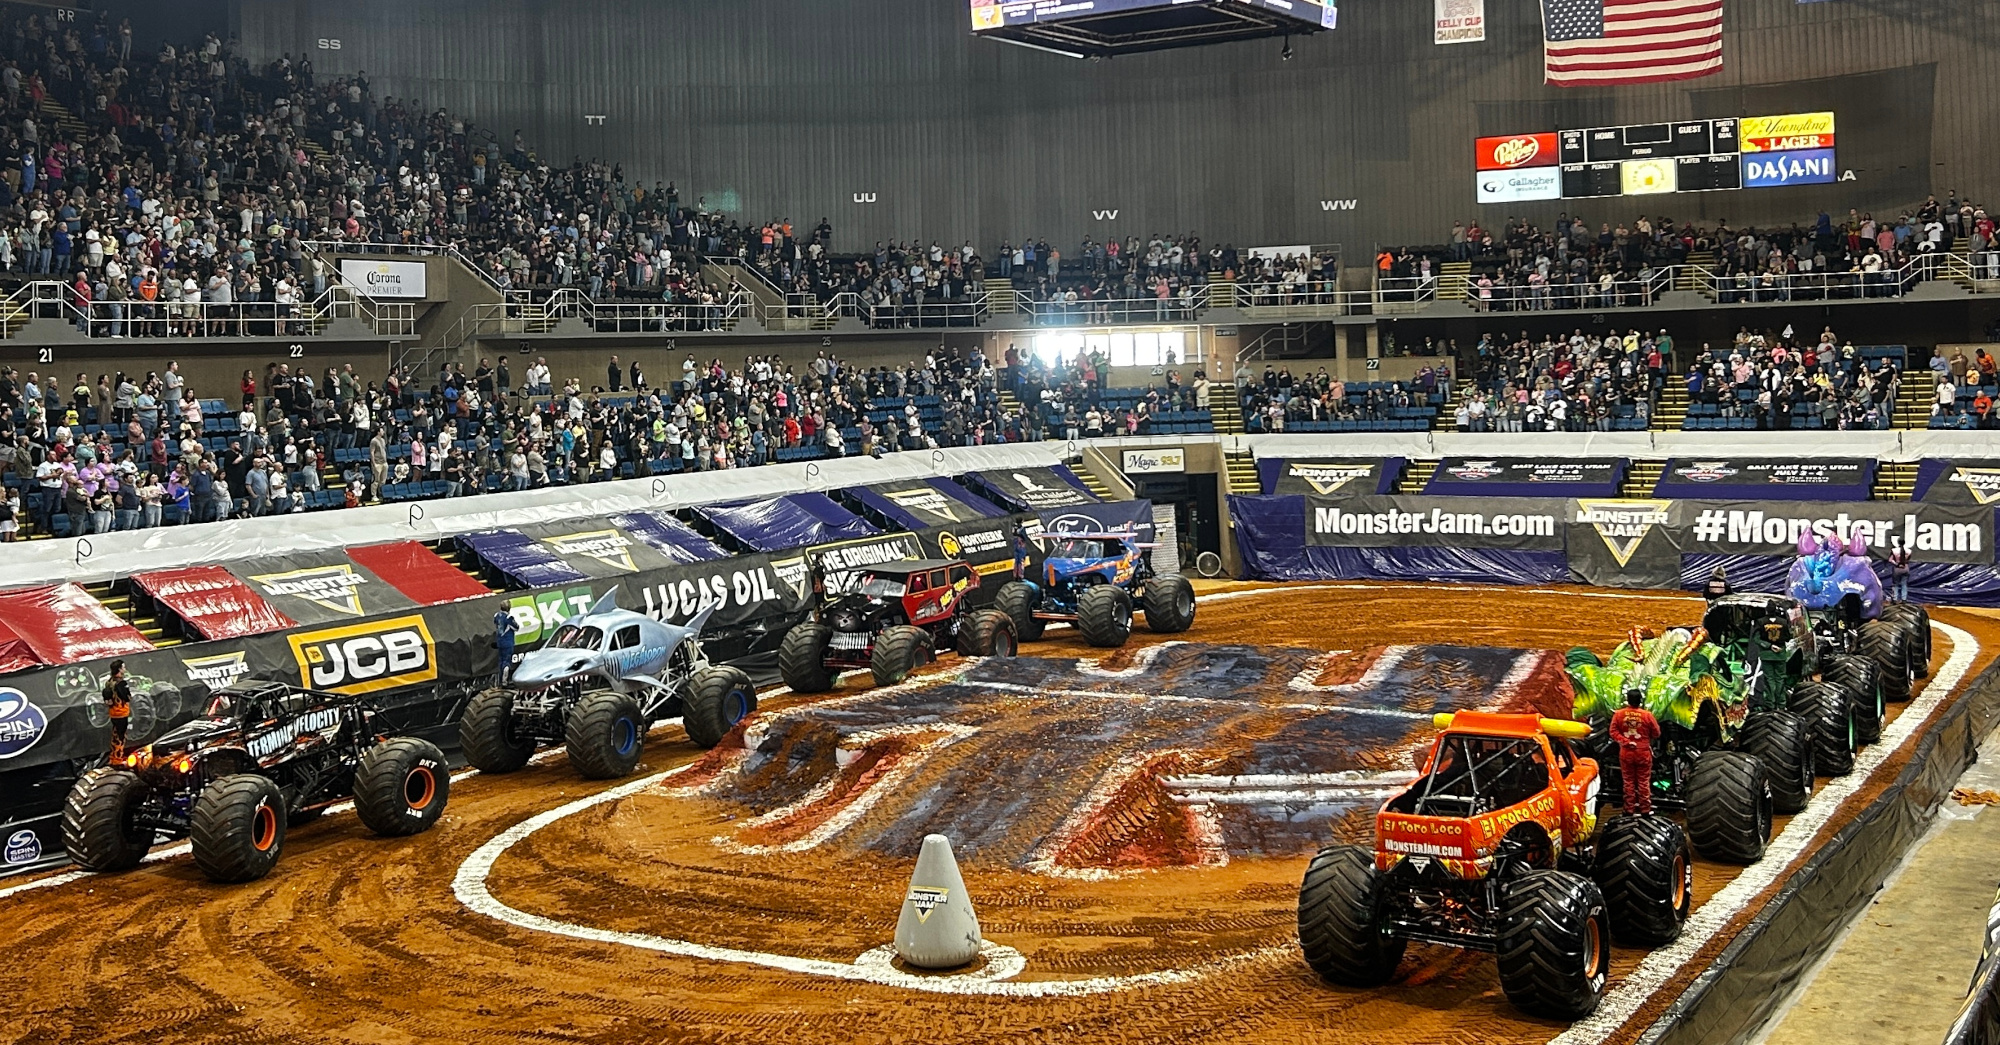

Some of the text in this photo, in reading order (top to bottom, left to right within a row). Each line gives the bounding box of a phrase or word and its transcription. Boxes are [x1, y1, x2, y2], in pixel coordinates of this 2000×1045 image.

[58, 9, 74, 22] RR
[1437, 16, 1481, 28] KELLY CUP
[1437, 27, 1482, 41] CHAMPIONS
[318, 38, 341, 50] SS
[585, 115, 606, 125] TT
[1758, 116, 1830, 136] Yuengling
[1595, 132, 1615, 140] HOME
[1678, 125, 1702, 134] GUEST
[1508, 139, 1526, 151] Dr
[1770, 135, 1820, 150] LAGER
[1499, 142, 1535, 164] Pepper
[1748, 156, 1828, 181] DASANI
[1509, 176, 1555, 188] Gallagher
[853, 192, 877, 203] UU
[1320, 199, 1357, 211] WW
[1092, 209, 1119, 220] VV
[367, 271, 401, 285] Corona
[367, 286, 402, 295] PREMIER
[39, 347, 53, 363] 21
[290, 344, 303, 358] 22
[1151, 366, 1163, 375] 26
[1366, 359, 1379, 369] 27
[1127, 454, 1181, 471] Magic 93.7
[1289, 468, 1371, 477] MONSTER
[1315, 507, 1554, 536] MonsterJam.com
[1576, 510, 1668, 524] MONSTER
[1601, 523, 1643, 537] JAM
[1692, 509, 1981, 552] #MonsterJam
[553, 536, 633, 555] MONSTER
[958, 530, 1005, 547] NORTHERN
[592, 546, 627, 557] JAM
[841, 541, 905, 566] ORIGINAL
[773, 563, 809, 577] MONSTER
[261, 573, 368, 596] MONSTER
[783, 573, 805, 584] JAM
[308, 588, 355, 600] JAM
[642, 575, 728, 621] LUCAS
[509, 594, 592, 636] BKT
[313, 630, 426, 686] JCB
[622, 645, 667, 672] MEGALODON
[187, 662, 250, 680] MONSTER
[208, 676, 234, 689] JAM
[0, 717, 35, 732] PIN
[247, 707, 340, 757] TERMIN VELOCITY
[418, 758, 438, 769] BKT
[1480, 796, 1555, 840] El Toro Loco
[1383, 819, 1463, 835] El Toro Loco
[10, 846, 36, 856] SPIN
[10, 852, 36, 862] MASTER
[908, 892, 948, 903] MONSTER
[915, 900, 934, 909] JAM
